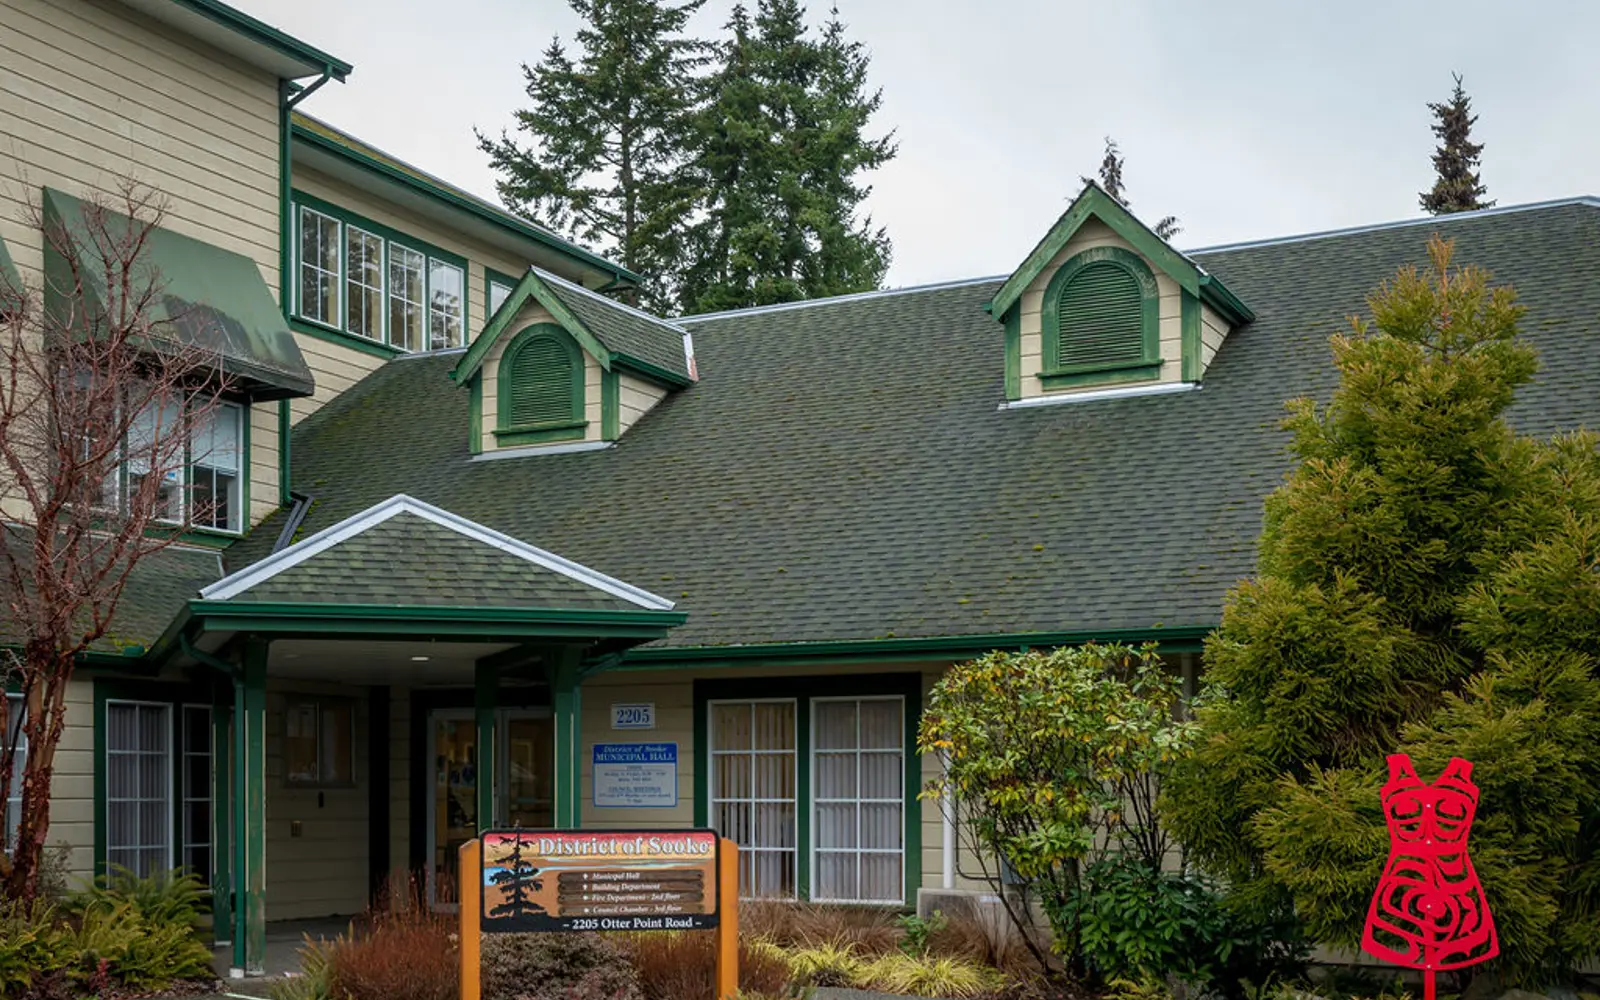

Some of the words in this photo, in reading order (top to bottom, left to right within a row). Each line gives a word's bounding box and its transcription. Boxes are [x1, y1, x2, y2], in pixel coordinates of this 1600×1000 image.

[617, 709, 650, 723] 2205
[635, 745, 643, 753] of
[596, 752, 648, 761] MUNICIPAL
[649, 752, 675, 761] HALL
[539, 837, 617, 856] District
[622, 836, 643, 855] of
[649, 836, 710, 855] Sooke
[592, 872, 624, 881] Municipal
[626, 872, 641, 880] Hall
[592, 883, 620, 892] Building
[621, 883, 660, 891] Department
[607, 894, 646, 903] Department
[592, 905, 618, 914] Council
[619, 905, 649, 913] Chamber
[572, 919, 599, 930] 2205
[601, 918, 631, 929] Otter
[633, 917, 663, 928] Point
[665, 917, 693, 928] Road
